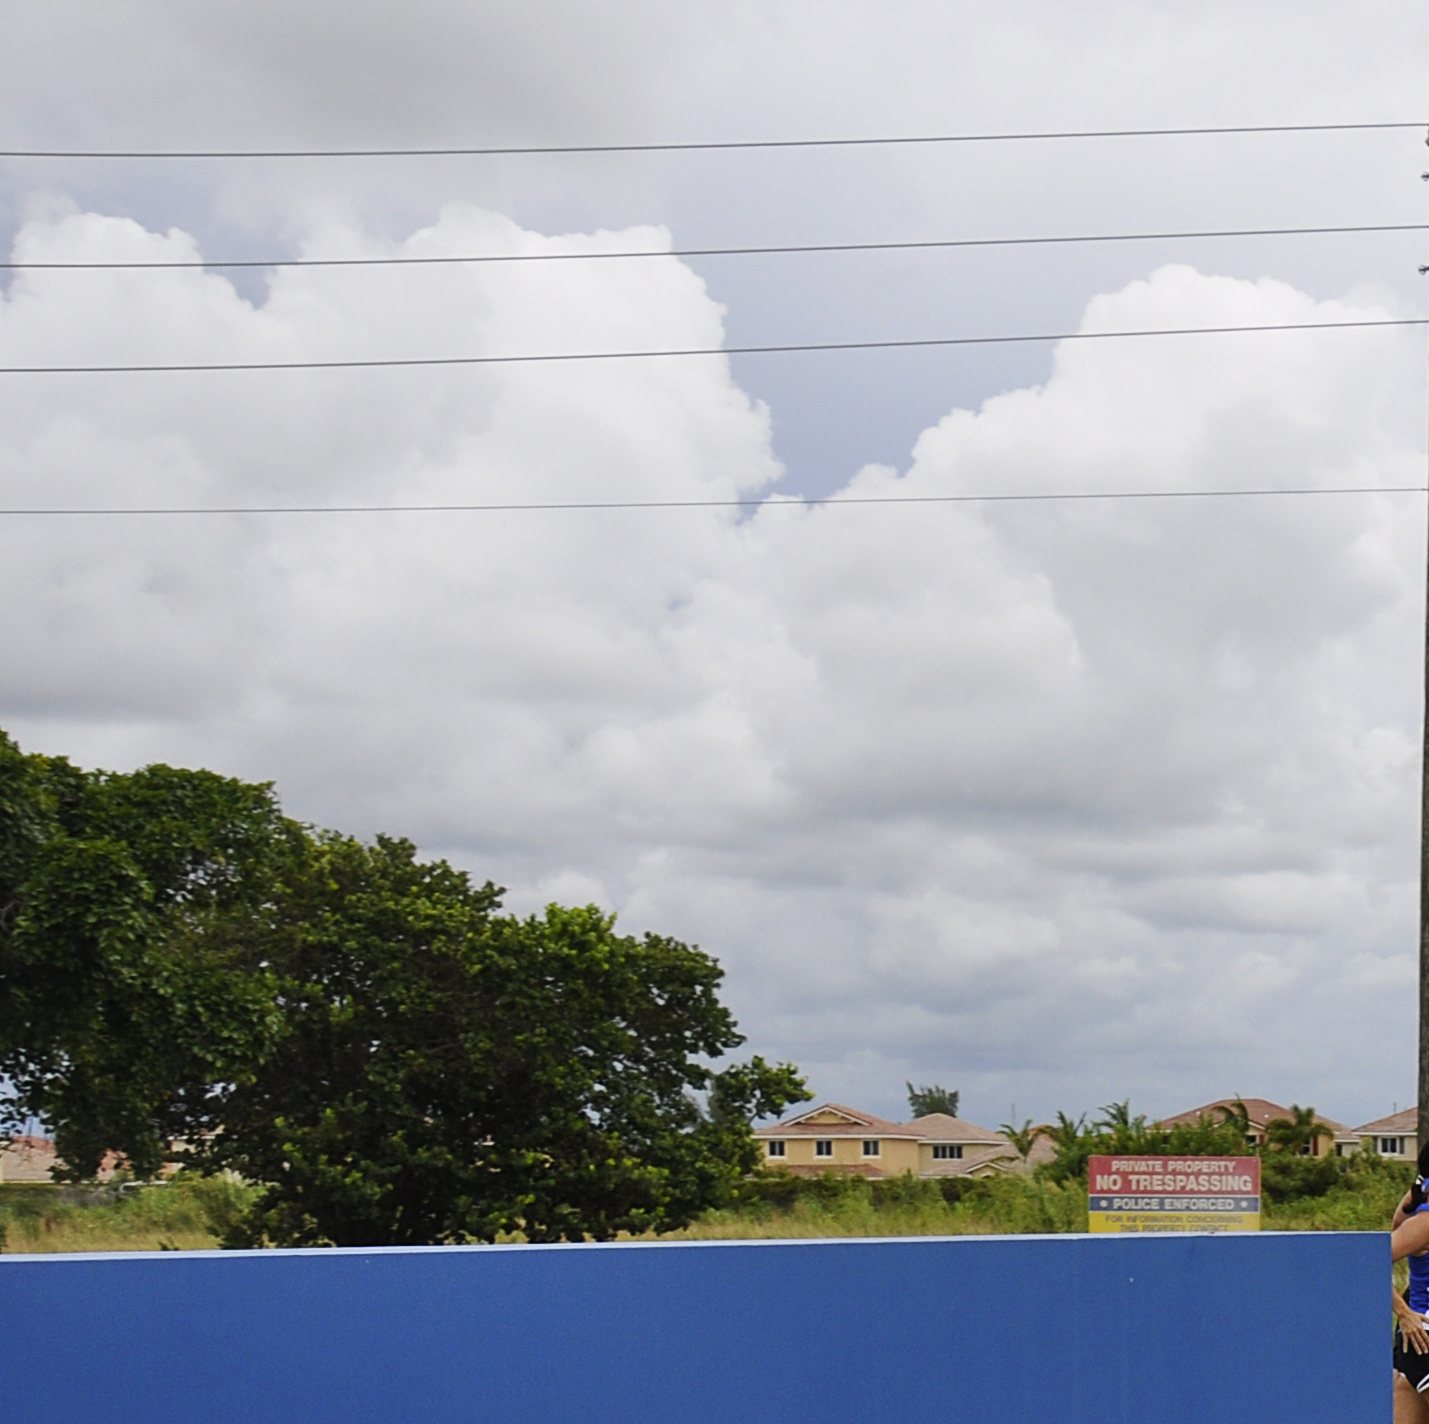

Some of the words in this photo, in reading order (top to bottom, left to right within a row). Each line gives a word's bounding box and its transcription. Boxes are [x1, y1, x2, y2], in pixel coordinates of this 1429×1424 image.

[1111, 1160, 1163, 1172] PRIVATE
[1167, 1160, 1236, 1172] PROPERTY
[1096, 1174, 1122, 1191] NO
[1128, 1174, 1252, 1191] TRESPASSING
[1113, 1198, 1160, 1210] POLICE
[1164, 1198, 1235, 1210] ENFORCED
[1105, 1215, 1123, 1223] FOR
[1126, 1215, 1184, 1223] INFORMATION
[1187, 1215, 1244, 1223] CONCERNING
